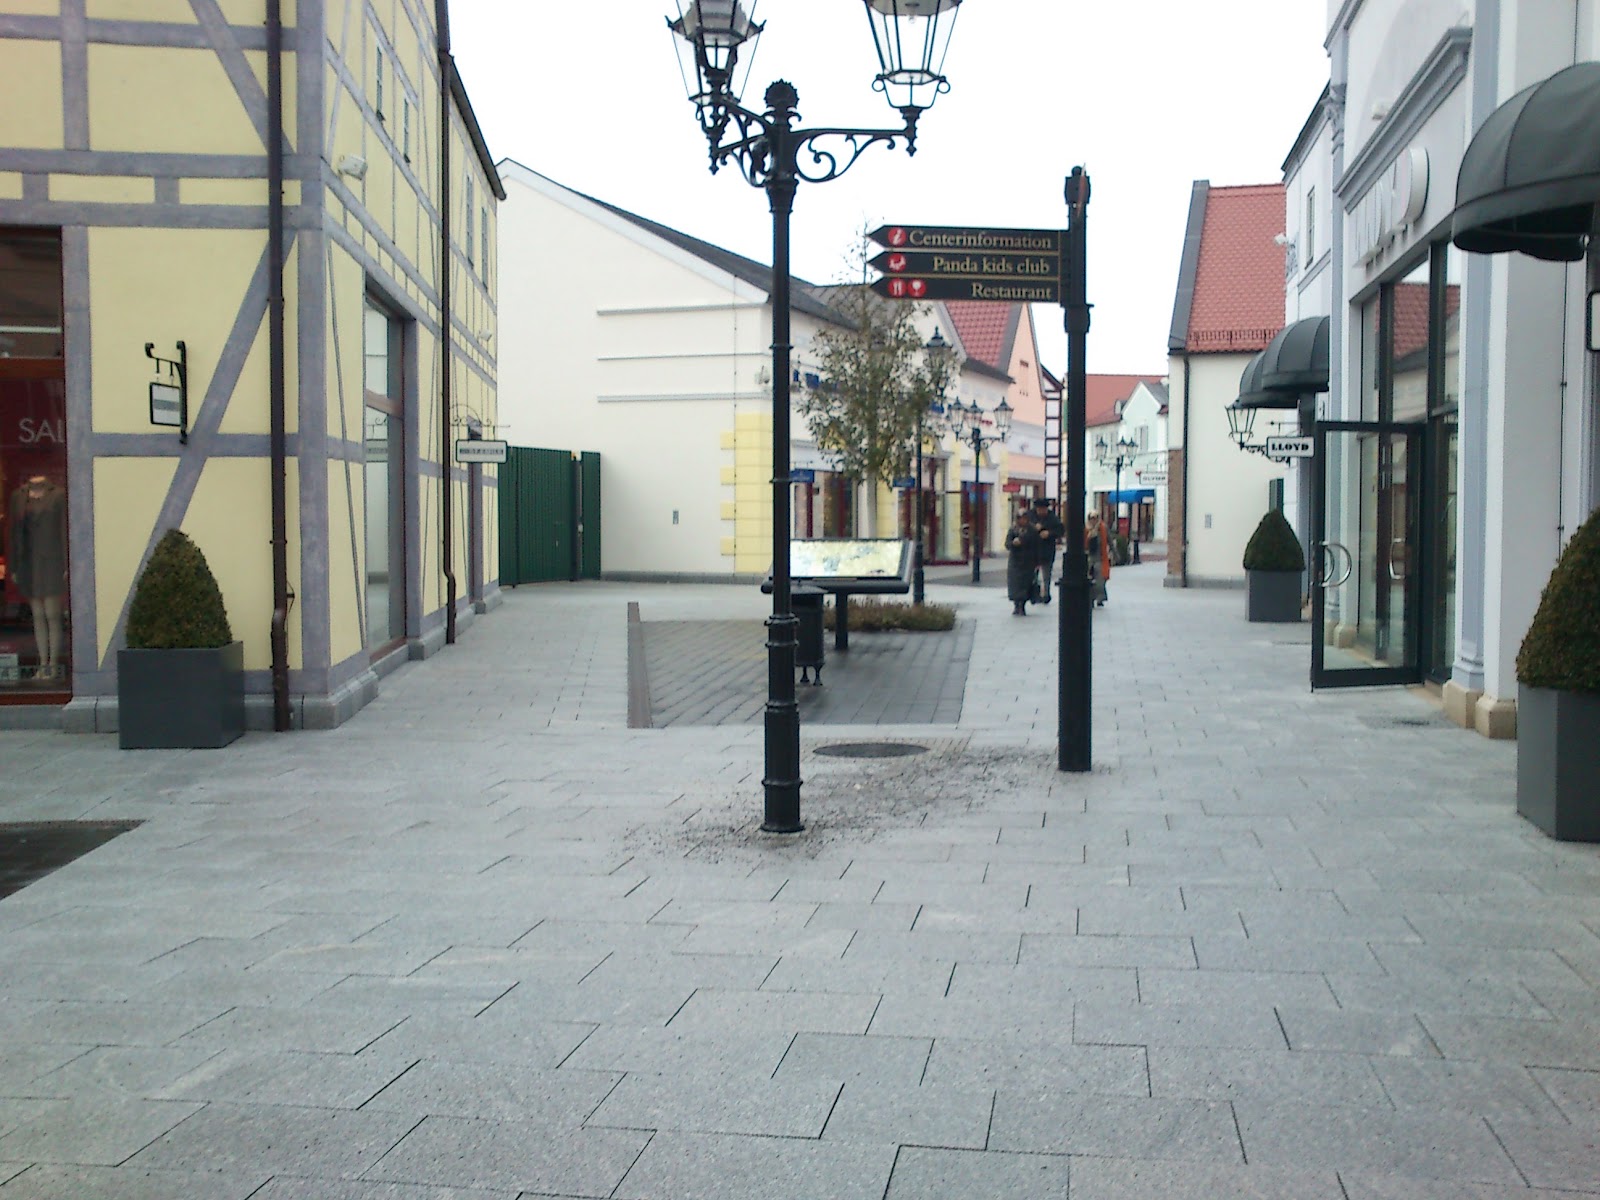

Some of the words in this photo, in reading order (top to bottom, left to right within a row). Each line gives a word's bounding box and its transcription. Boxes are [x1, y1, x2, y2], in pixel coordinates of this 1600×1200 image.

[909, 229, 1051, 249] Centerinformation
[933, 256, 978, 272] Panda
[982, 257, 1013, 273] kids
[1017, 257, 1050, 274] club
[971, 282, 1051, 298] Restaurant
[1271, 443, 1310, 451] LLOYD
